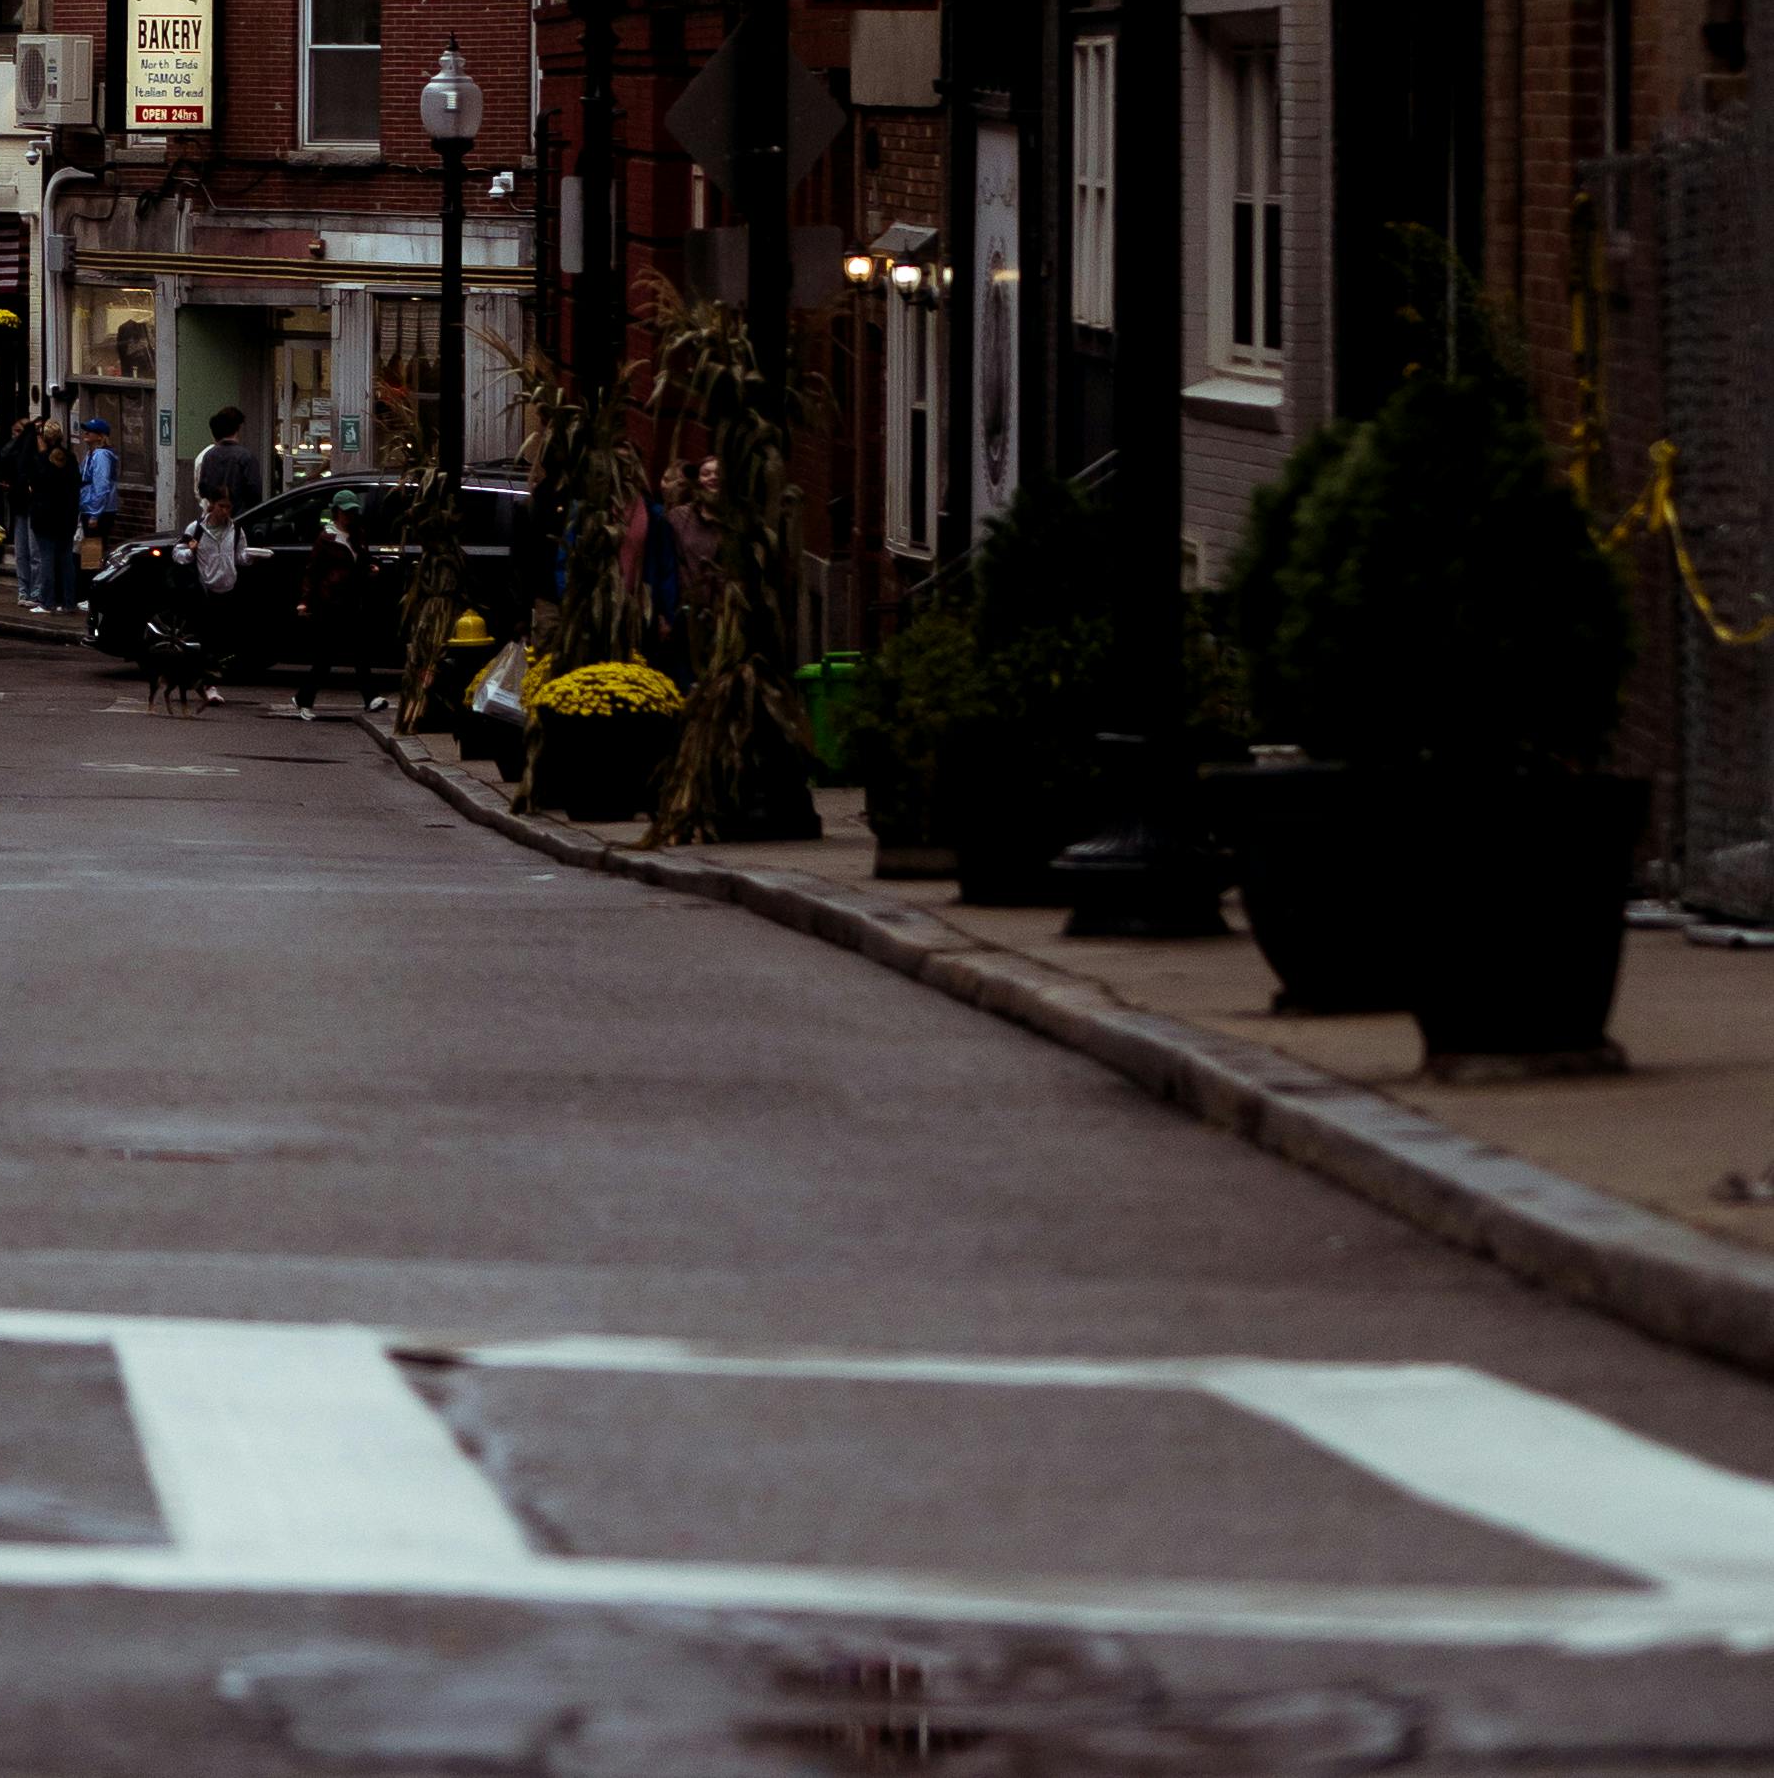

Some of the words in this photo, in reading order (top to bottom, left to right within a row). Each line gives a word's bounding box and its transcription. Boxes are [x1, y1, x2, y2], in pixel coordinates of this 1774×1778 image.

[138, 19, 202, 50] BAKERY
[141, 58, 169, 69] North
[175, 58, 198, 69] Ends
[134, 86, 168, 97] Italian
[173, 86, 204, 97] Bread
[141, 108, 168, 121] OPEN
[171, 108, 198, 121] 24hrs
